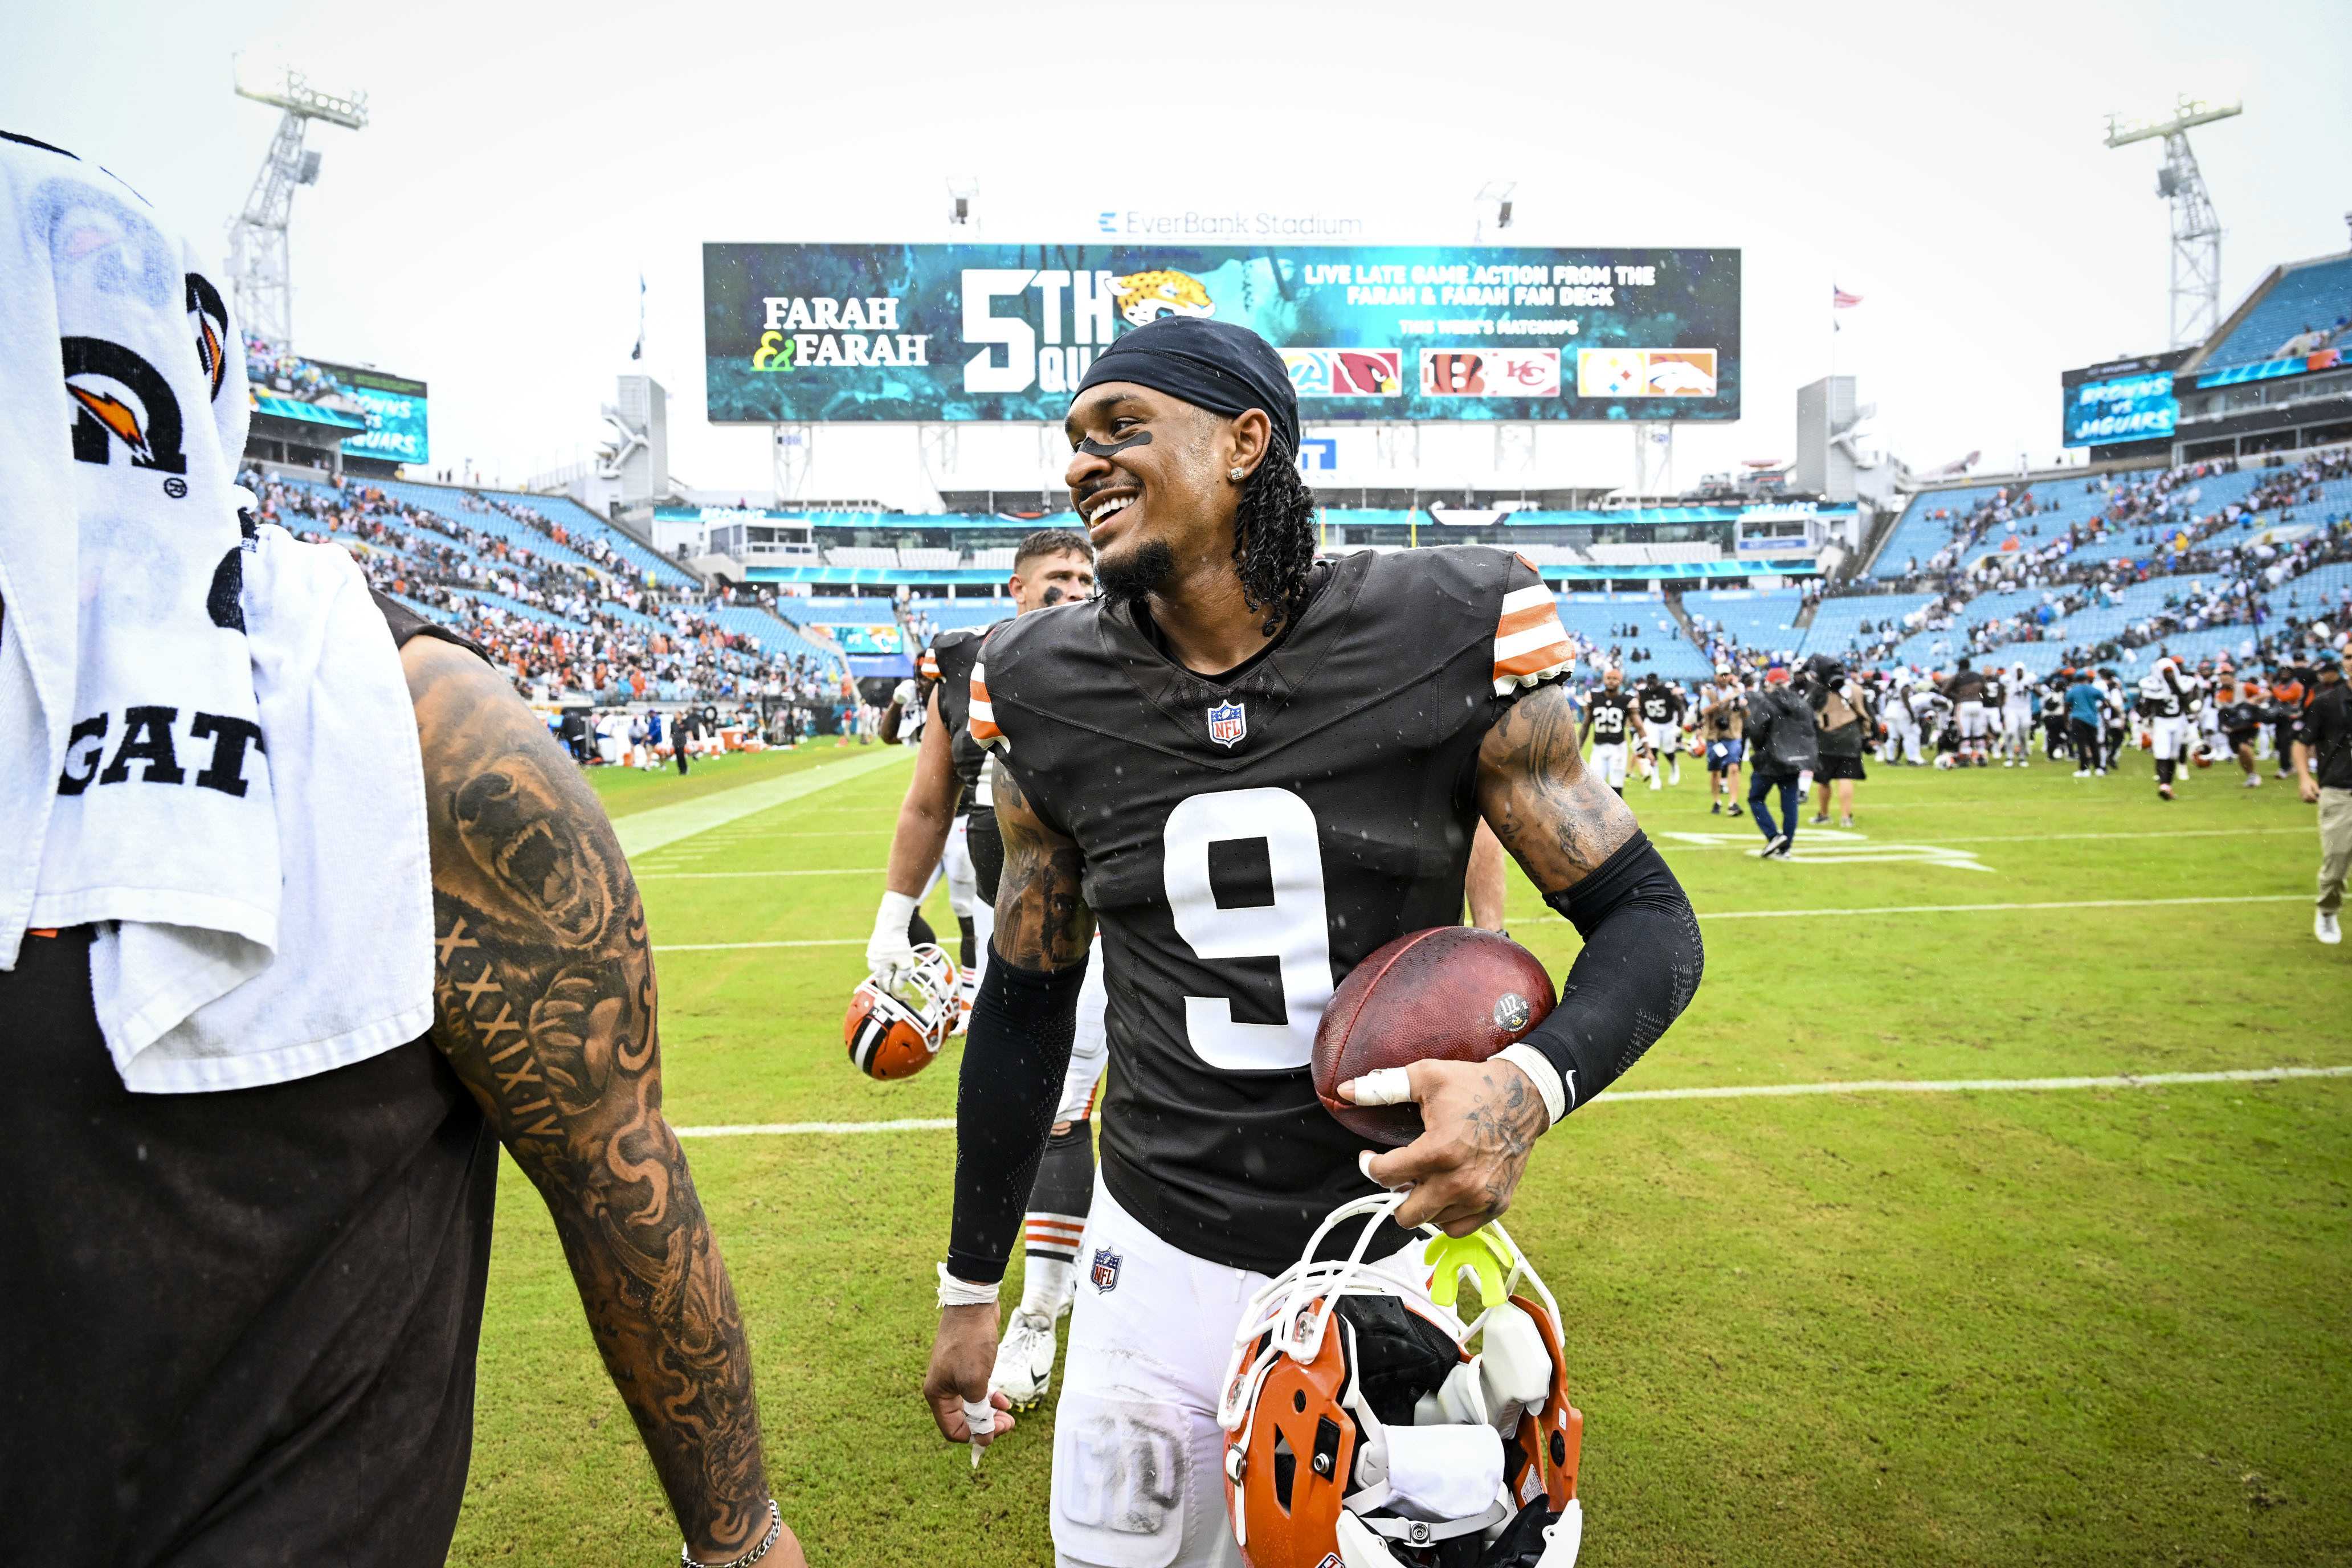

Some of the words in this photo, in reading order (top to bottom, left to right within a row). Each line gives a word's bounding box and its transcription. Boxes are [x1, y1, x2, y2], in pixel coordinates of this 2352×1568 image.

[1126, 211, 1249, 233] EverBank
[1256, 211, 1362, 233] Stadium
[1305, 265, 1351, 284] LIVE
[1357, 265, 1406, 284] LATE
[1411, 265, 1469, 284] GAME
[1473, 266, 1549, 285] ACTION
[1553, 266, 1611, 285] FROM
[1615, 266, 1656, 285] THE
[1347, 287, 1415, 305] FARAH
[1421, 287, 1436, 305] &
[1442, 287, 1509, 306] FARAH
[1514, 287, 1555, 306] FAN
[1559, 287, 1615, 306] DECK
[762, 297, 899, 330] FARAH
[961, 268, 1113, 393] 5TH
[1399, 319, 1435, 334] THIS
[1438, 319, 1494, 335] WEEK'S
[1496, 319, 1579, 335] MATCHUPS
[2080, 377, 2170, 405] BROWNS
[2075, 409, 2172, 439] JAGUARS
[1214, 720, 1240, 739] NFL
[1592, 706, 1623, 734] 29
[1163, 787, 1334, 1070] 9
[1093, 1265, 1113, 1286] NFL
